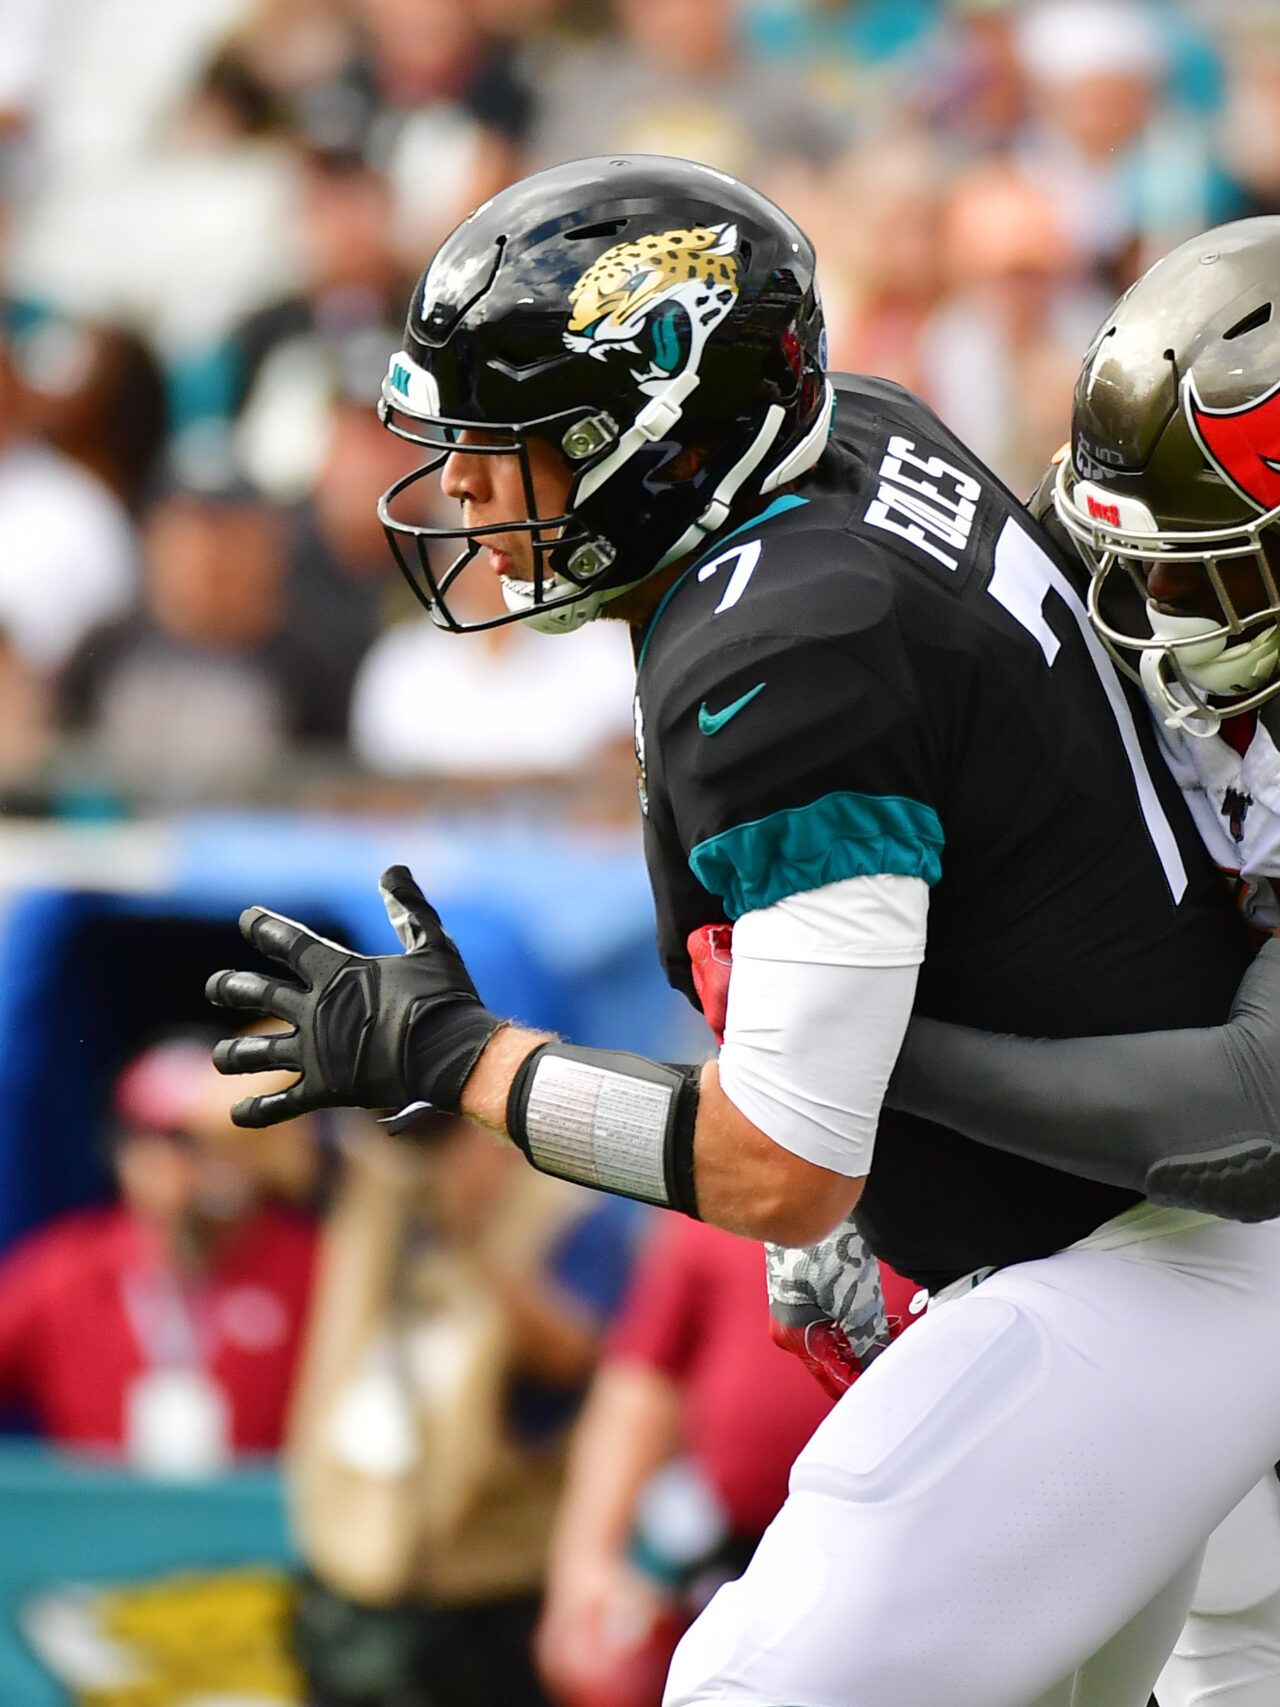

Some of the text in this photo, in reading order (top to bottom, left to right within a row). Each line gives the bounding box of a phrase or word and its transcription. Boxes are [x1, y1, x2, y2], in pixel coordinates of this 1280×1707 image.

[862, 435, 983, 573] FOLES
[697, 538, 763, 615] 7
[987, 515, 1189, 907] 7
